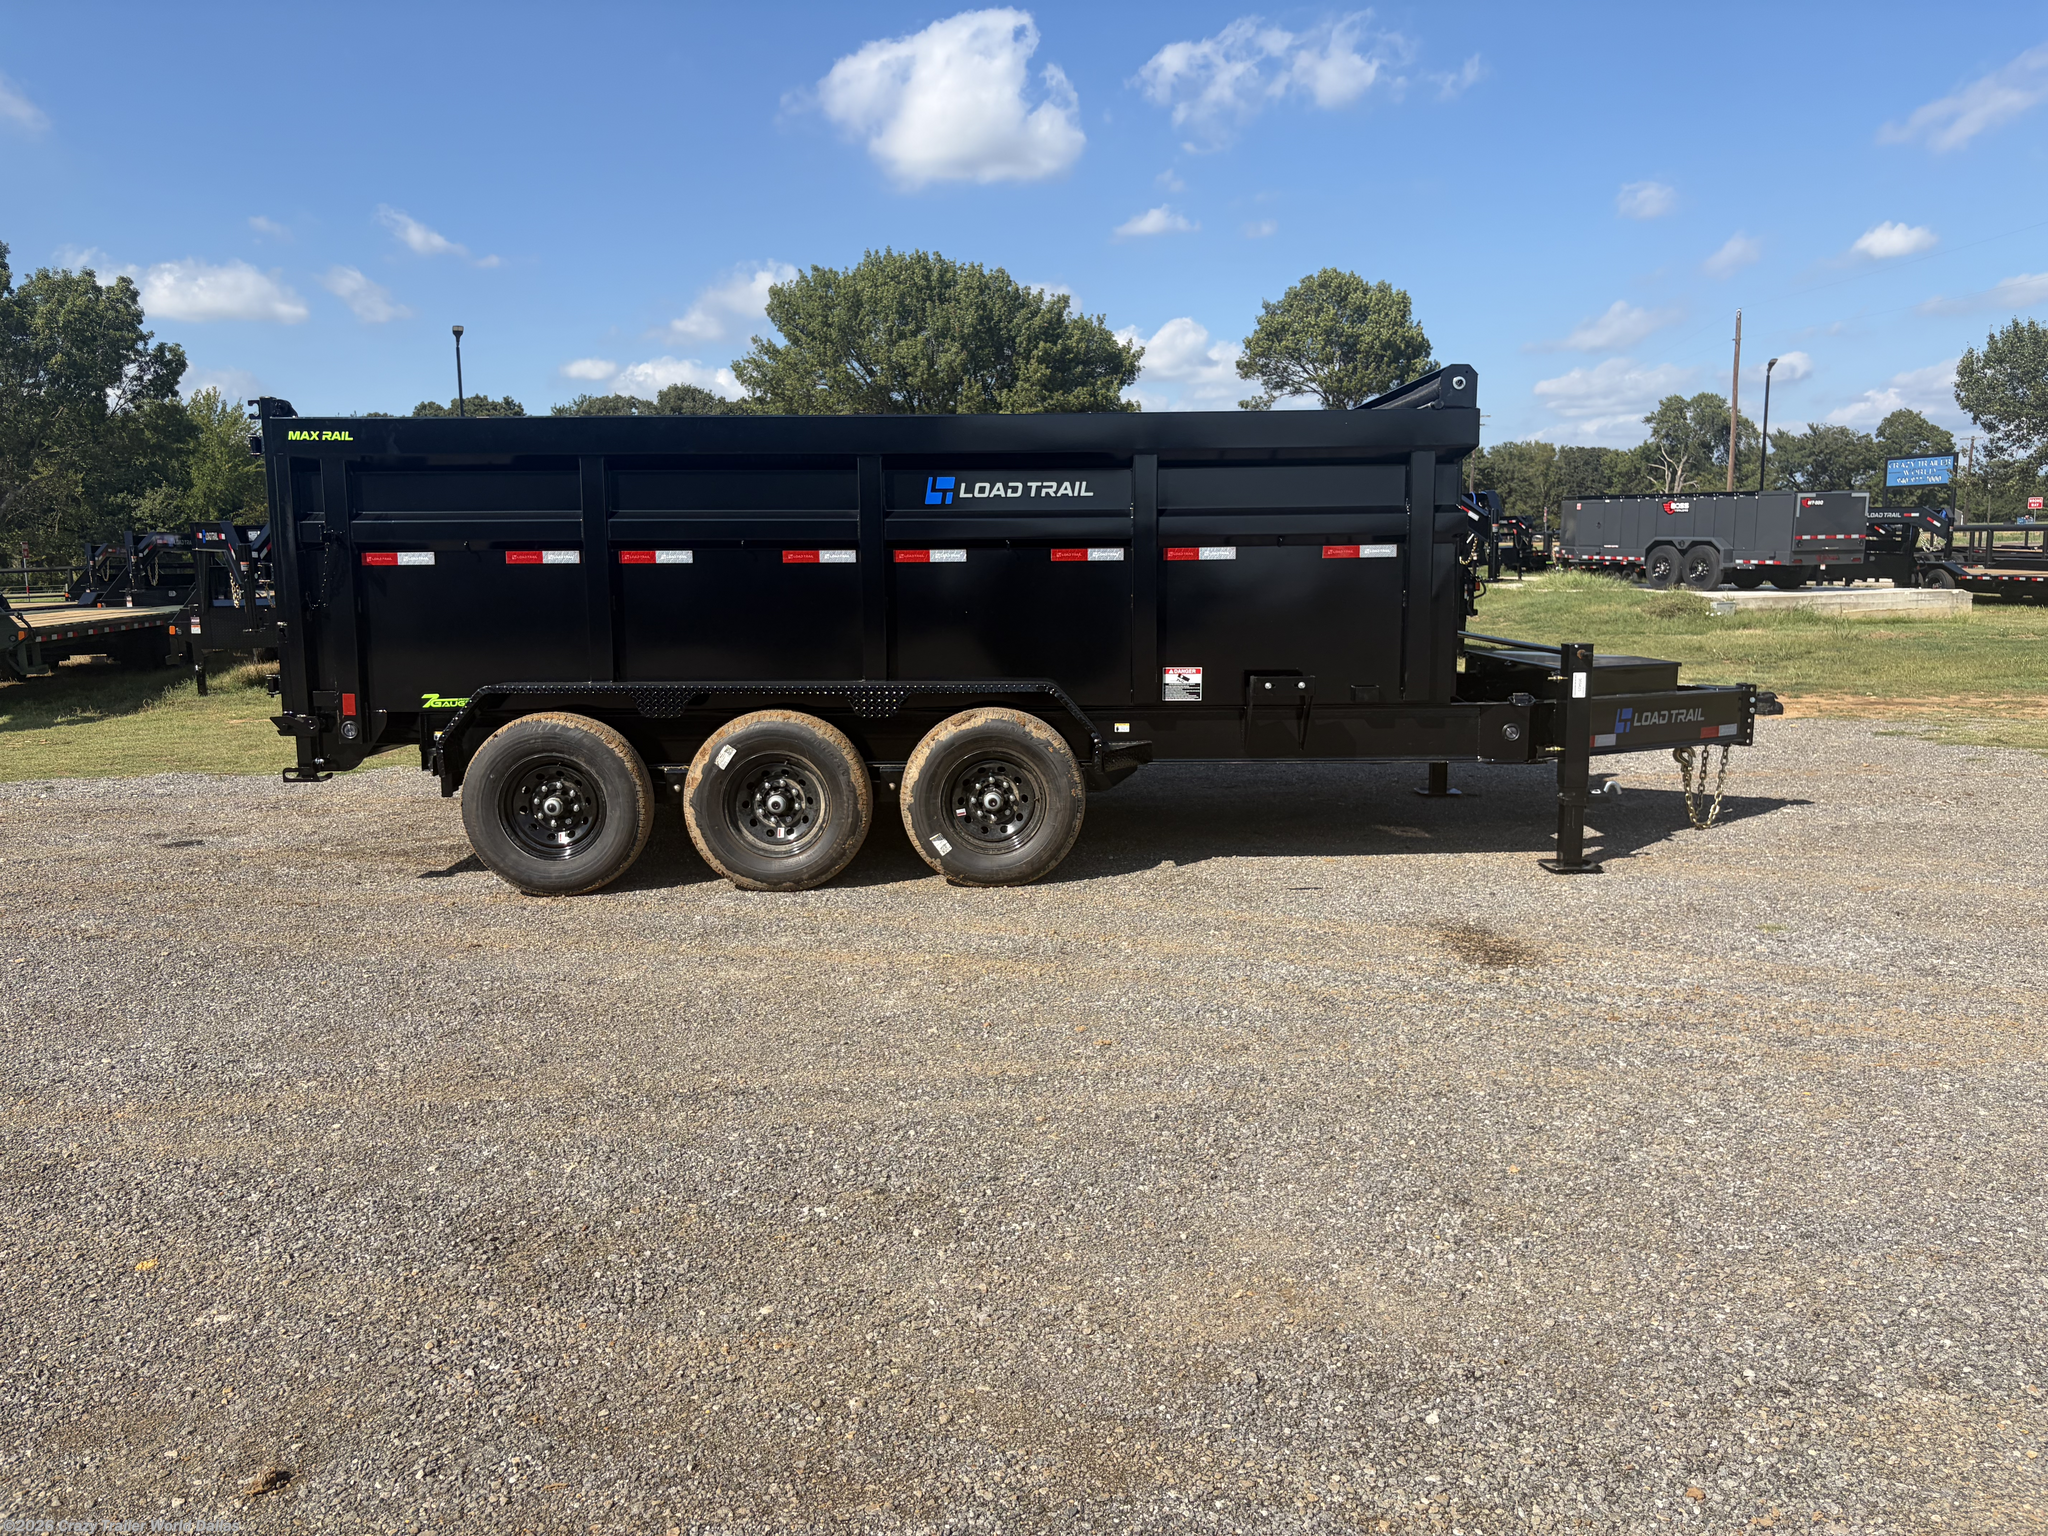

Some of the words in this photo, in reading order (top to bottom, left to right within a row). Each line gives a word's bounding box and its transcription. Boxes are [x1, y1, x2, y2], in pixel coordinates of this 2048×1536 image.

[287, 431, 320, 441] MAX
[321, 431, 354, 441] RAIL
[959, 482, 1023, 498] LOAD
[1027, 481, 1094, 497] TRAIL
[430, 700, 466, 708] GAUG
[1633, 711, 1668, 727] LOAD
[1670, 708, 1705, 723] TRAIL
